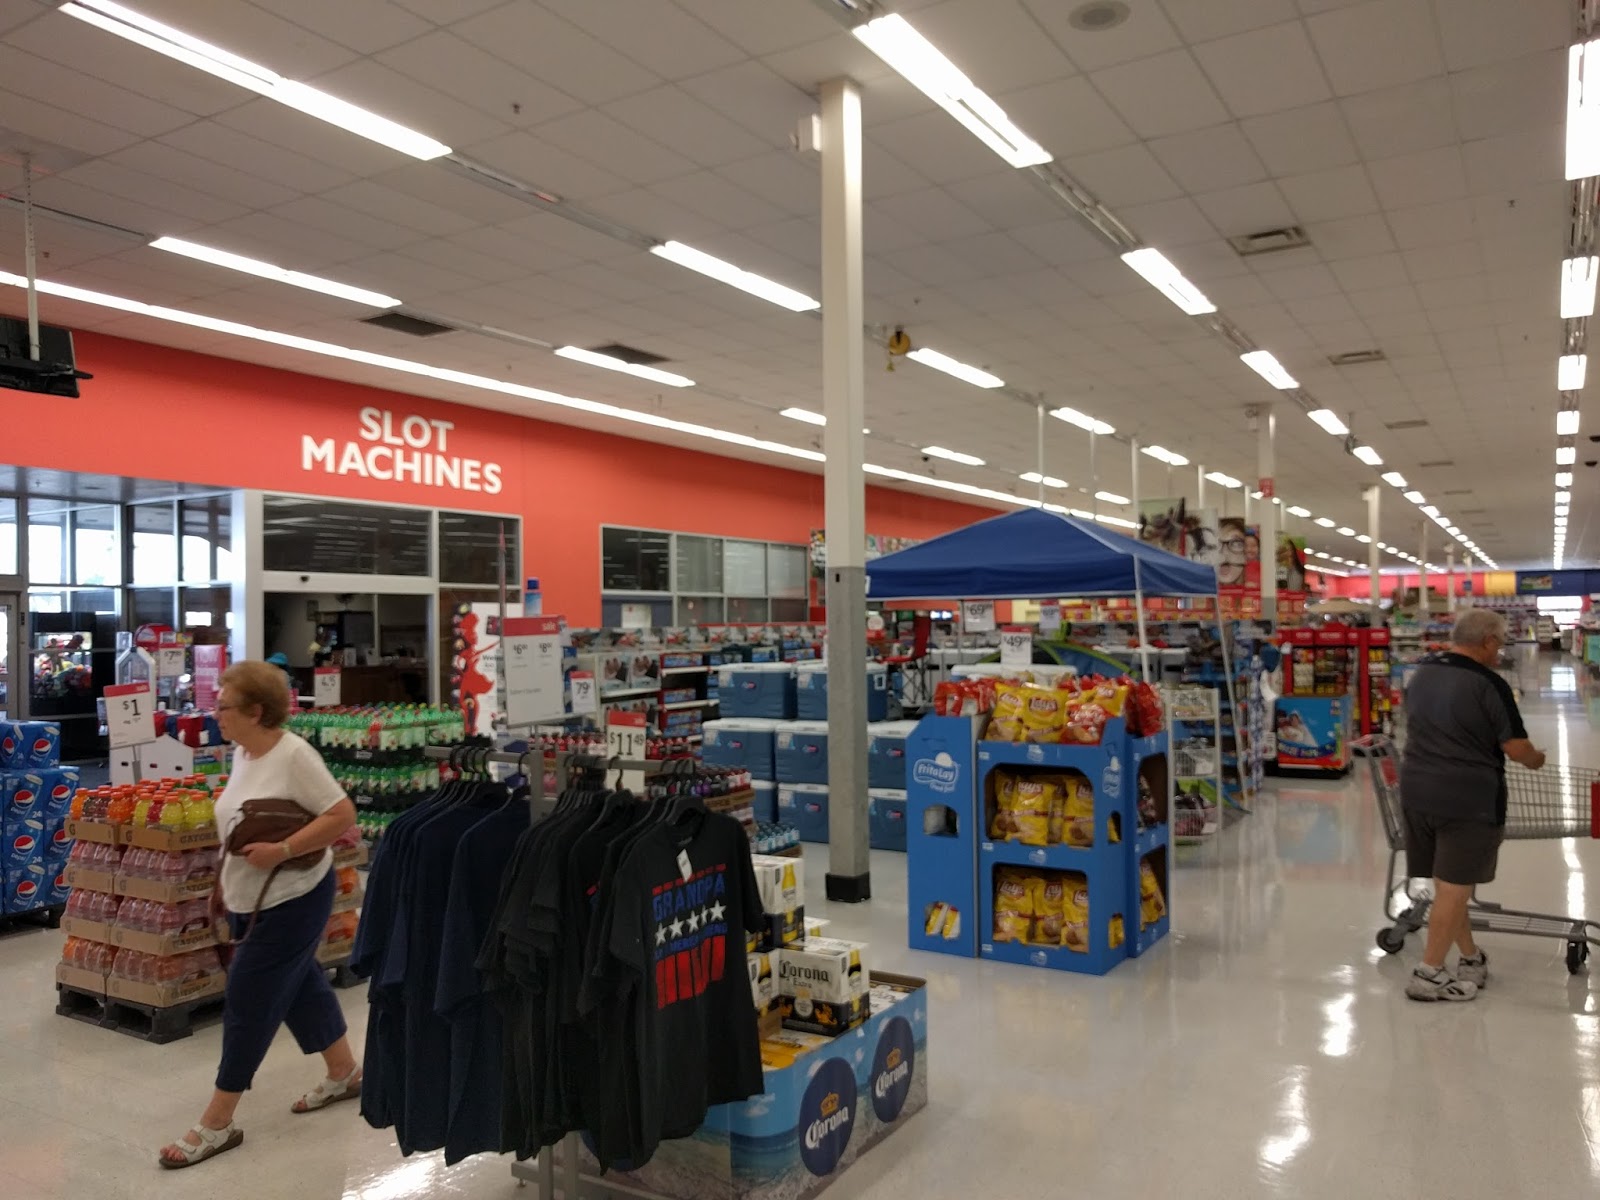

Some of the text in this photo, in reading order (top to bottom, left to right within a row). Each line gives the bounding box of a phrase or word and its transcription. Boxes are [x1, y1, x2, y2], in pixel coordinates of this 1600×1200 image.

[359, 406, 455, 452] SLOT
[302, 434, 502, 494] MACHINES
[653, 872, 727, 922] GRANDPA
[779, 959, 829, 983] Corona
[875, 1060, 908, 1098] Corona
[805, 1106, 849, 1150] Corona
